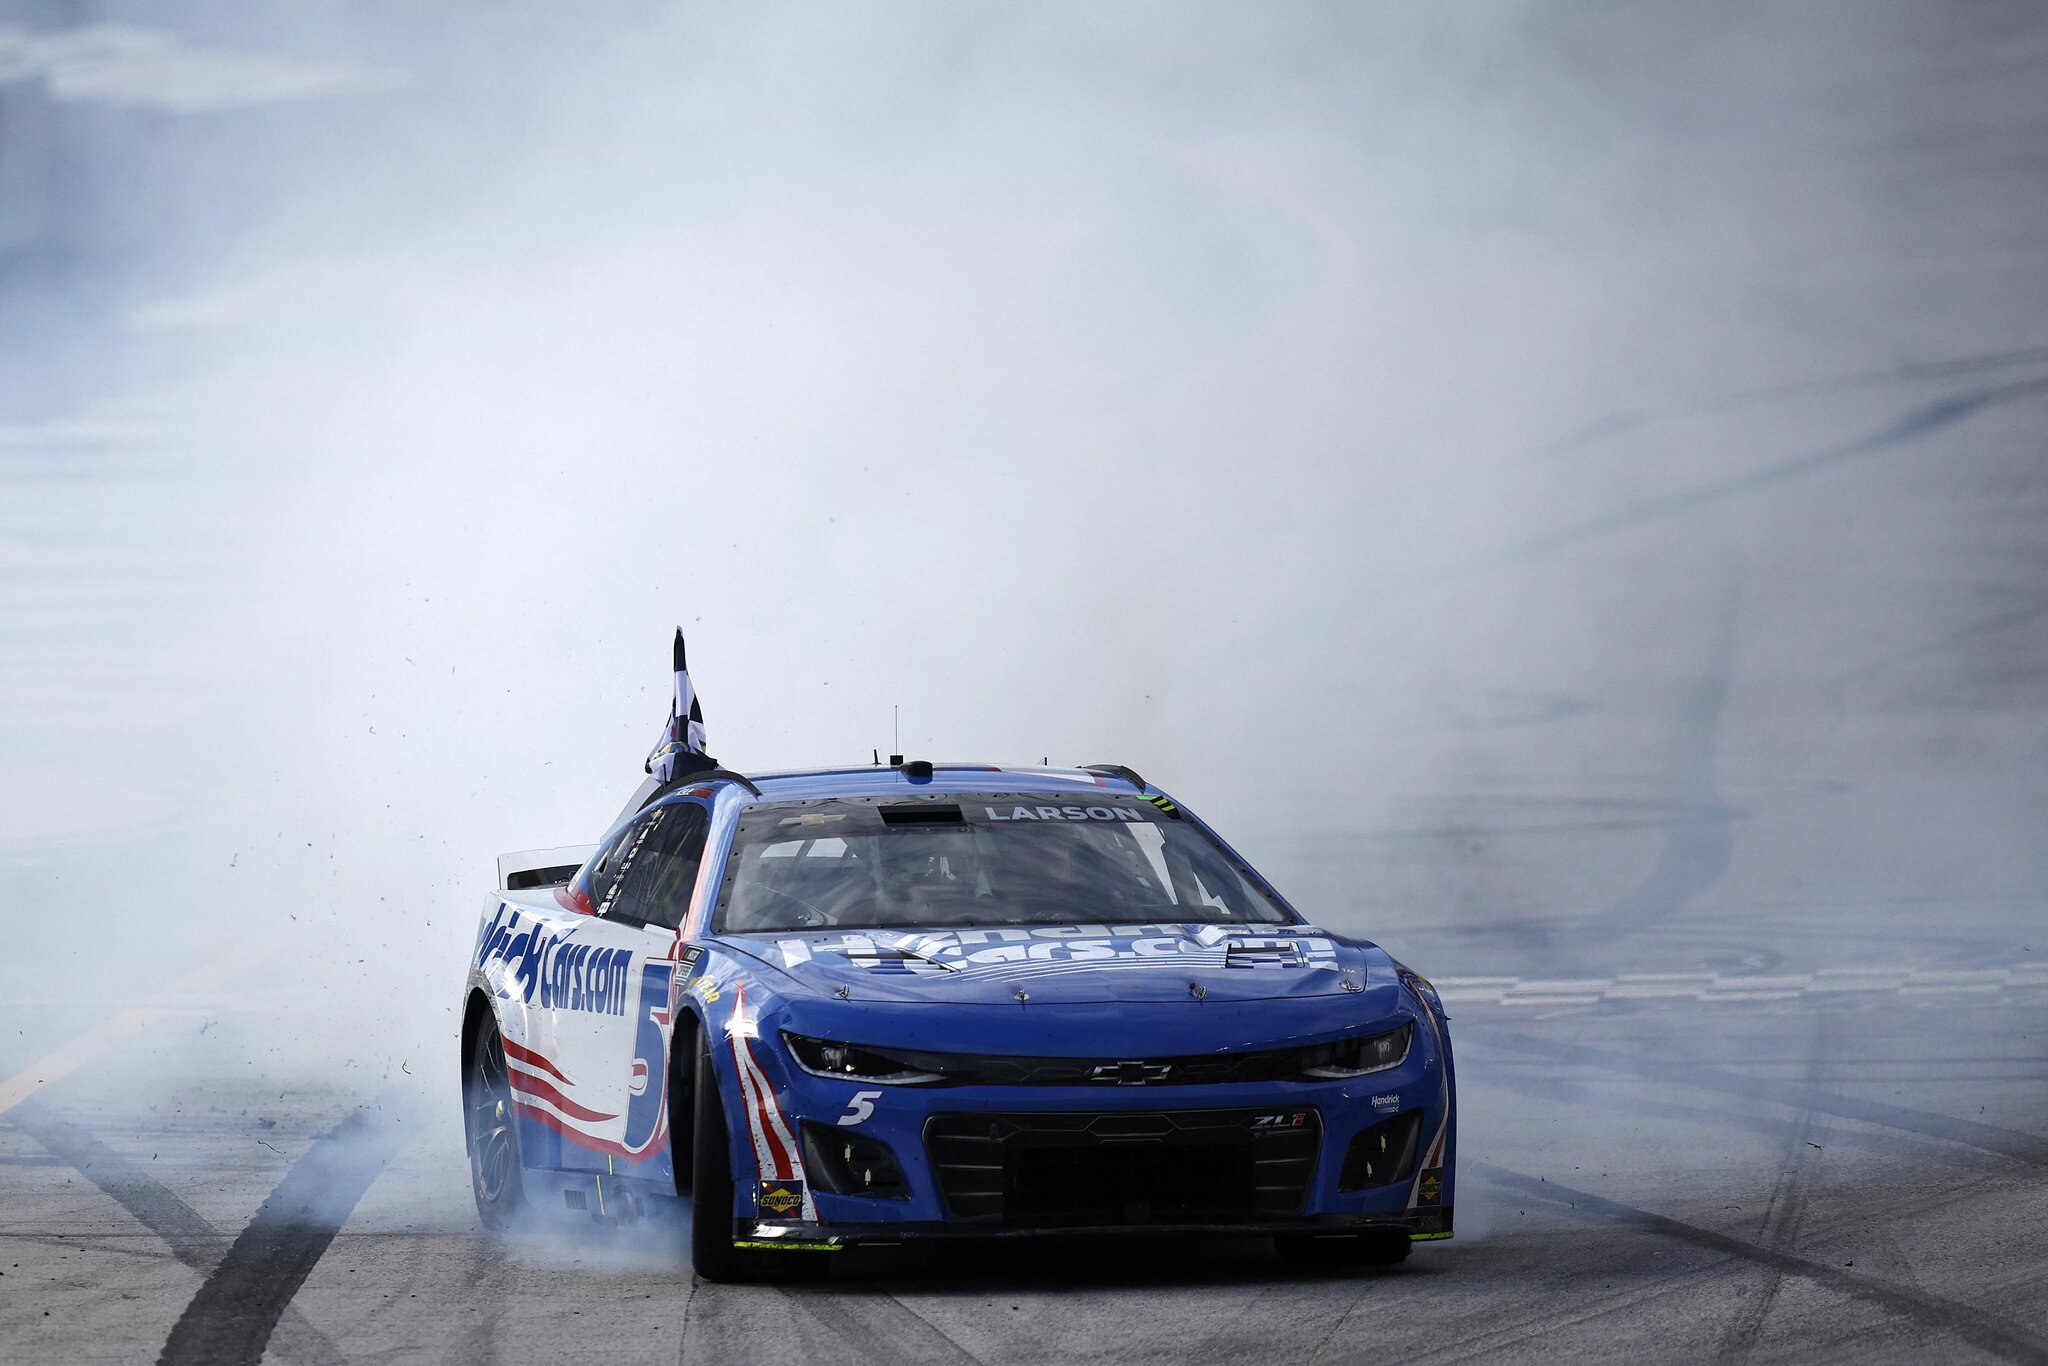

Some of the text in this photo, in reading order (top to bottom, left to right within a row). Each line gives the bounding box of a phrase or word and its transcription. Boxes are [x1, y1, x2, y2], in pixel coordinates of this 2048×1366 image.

[984, 806, 1145, 821] LARSON
[622, 963, 672, 1150] 5
[836, 1091, 883, 1126] 5
[1371, 1094, 1400, 1108] Hendrick
[1250, 1113, 1306, 1129] ZL1
[762, 1195, 800, 1206] SUNOCO
